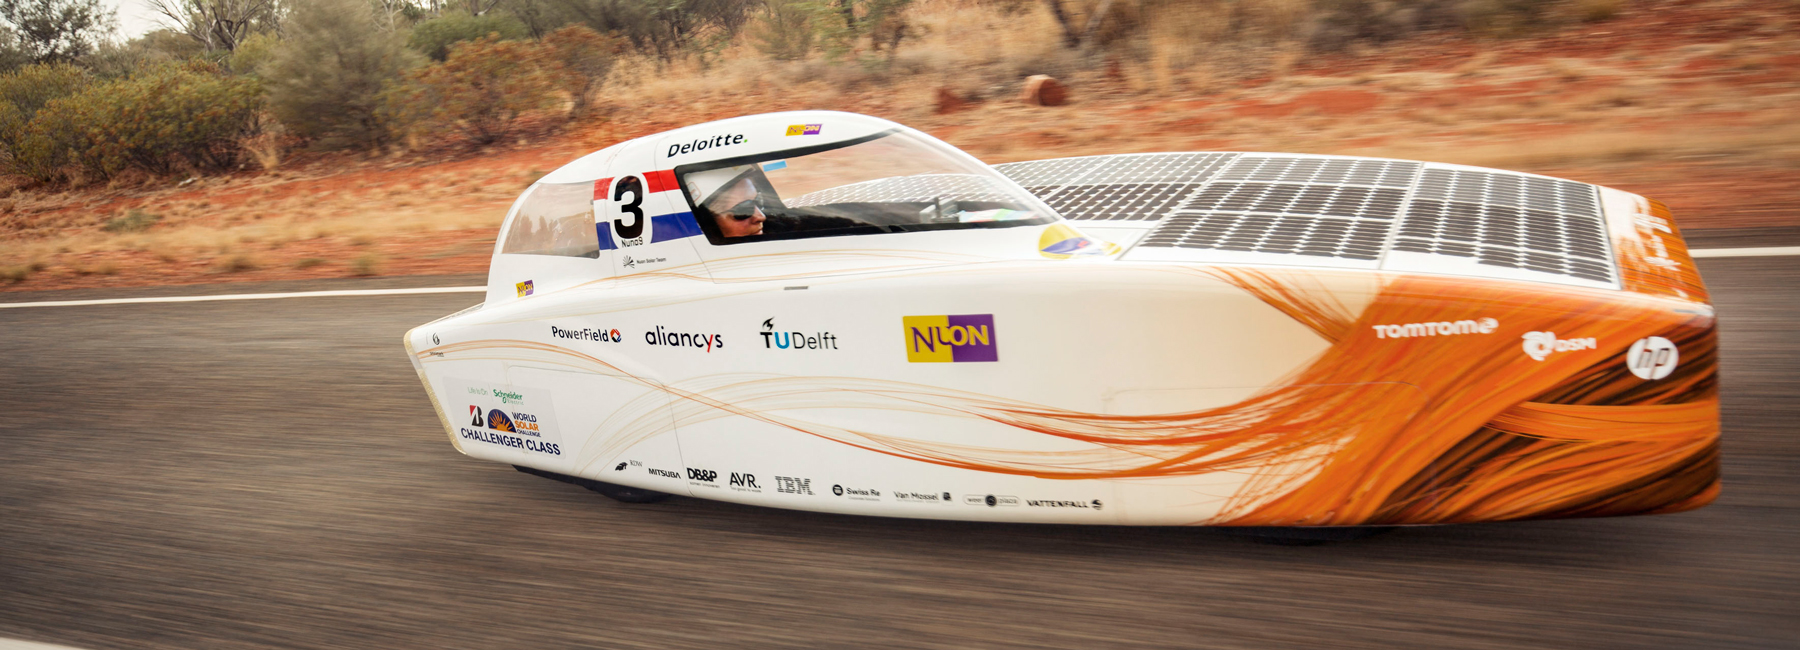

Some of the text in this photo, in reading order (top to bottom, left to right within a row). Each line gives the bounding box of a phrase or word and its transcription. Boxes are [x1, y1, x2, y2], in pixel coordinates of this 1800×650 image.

[667, 133, 748, 158] Deloitte.
[614, 175, 644, 239] 3
[621, 236, 643, 248] Nuna9
[552, 326, 609, 342] PowerField
[645, 325, 723, 353] aliancys
[910, 325, 990, 353] NUON
[1555, 337, 1597, 352] DSM
[1636, 337, 1671, 379] hp
[493, 389, 523, 404] Schneider
[512, 412, 536, 422] WORLD
[514, 421, 539, 432] SOLAR
[516, 430, 541, 438] CHALLENGE
[461, 427, 560, 456] CHALLENGER CLASS
[648, 468, 682, 480] MITSUBA
[774, 476, 814, 495] IBM
[846, 487, 880, 496] Swiss Re
[893, 491, 908, 499] Van
[1026, 500, 1088, 508] VATTENFALL
